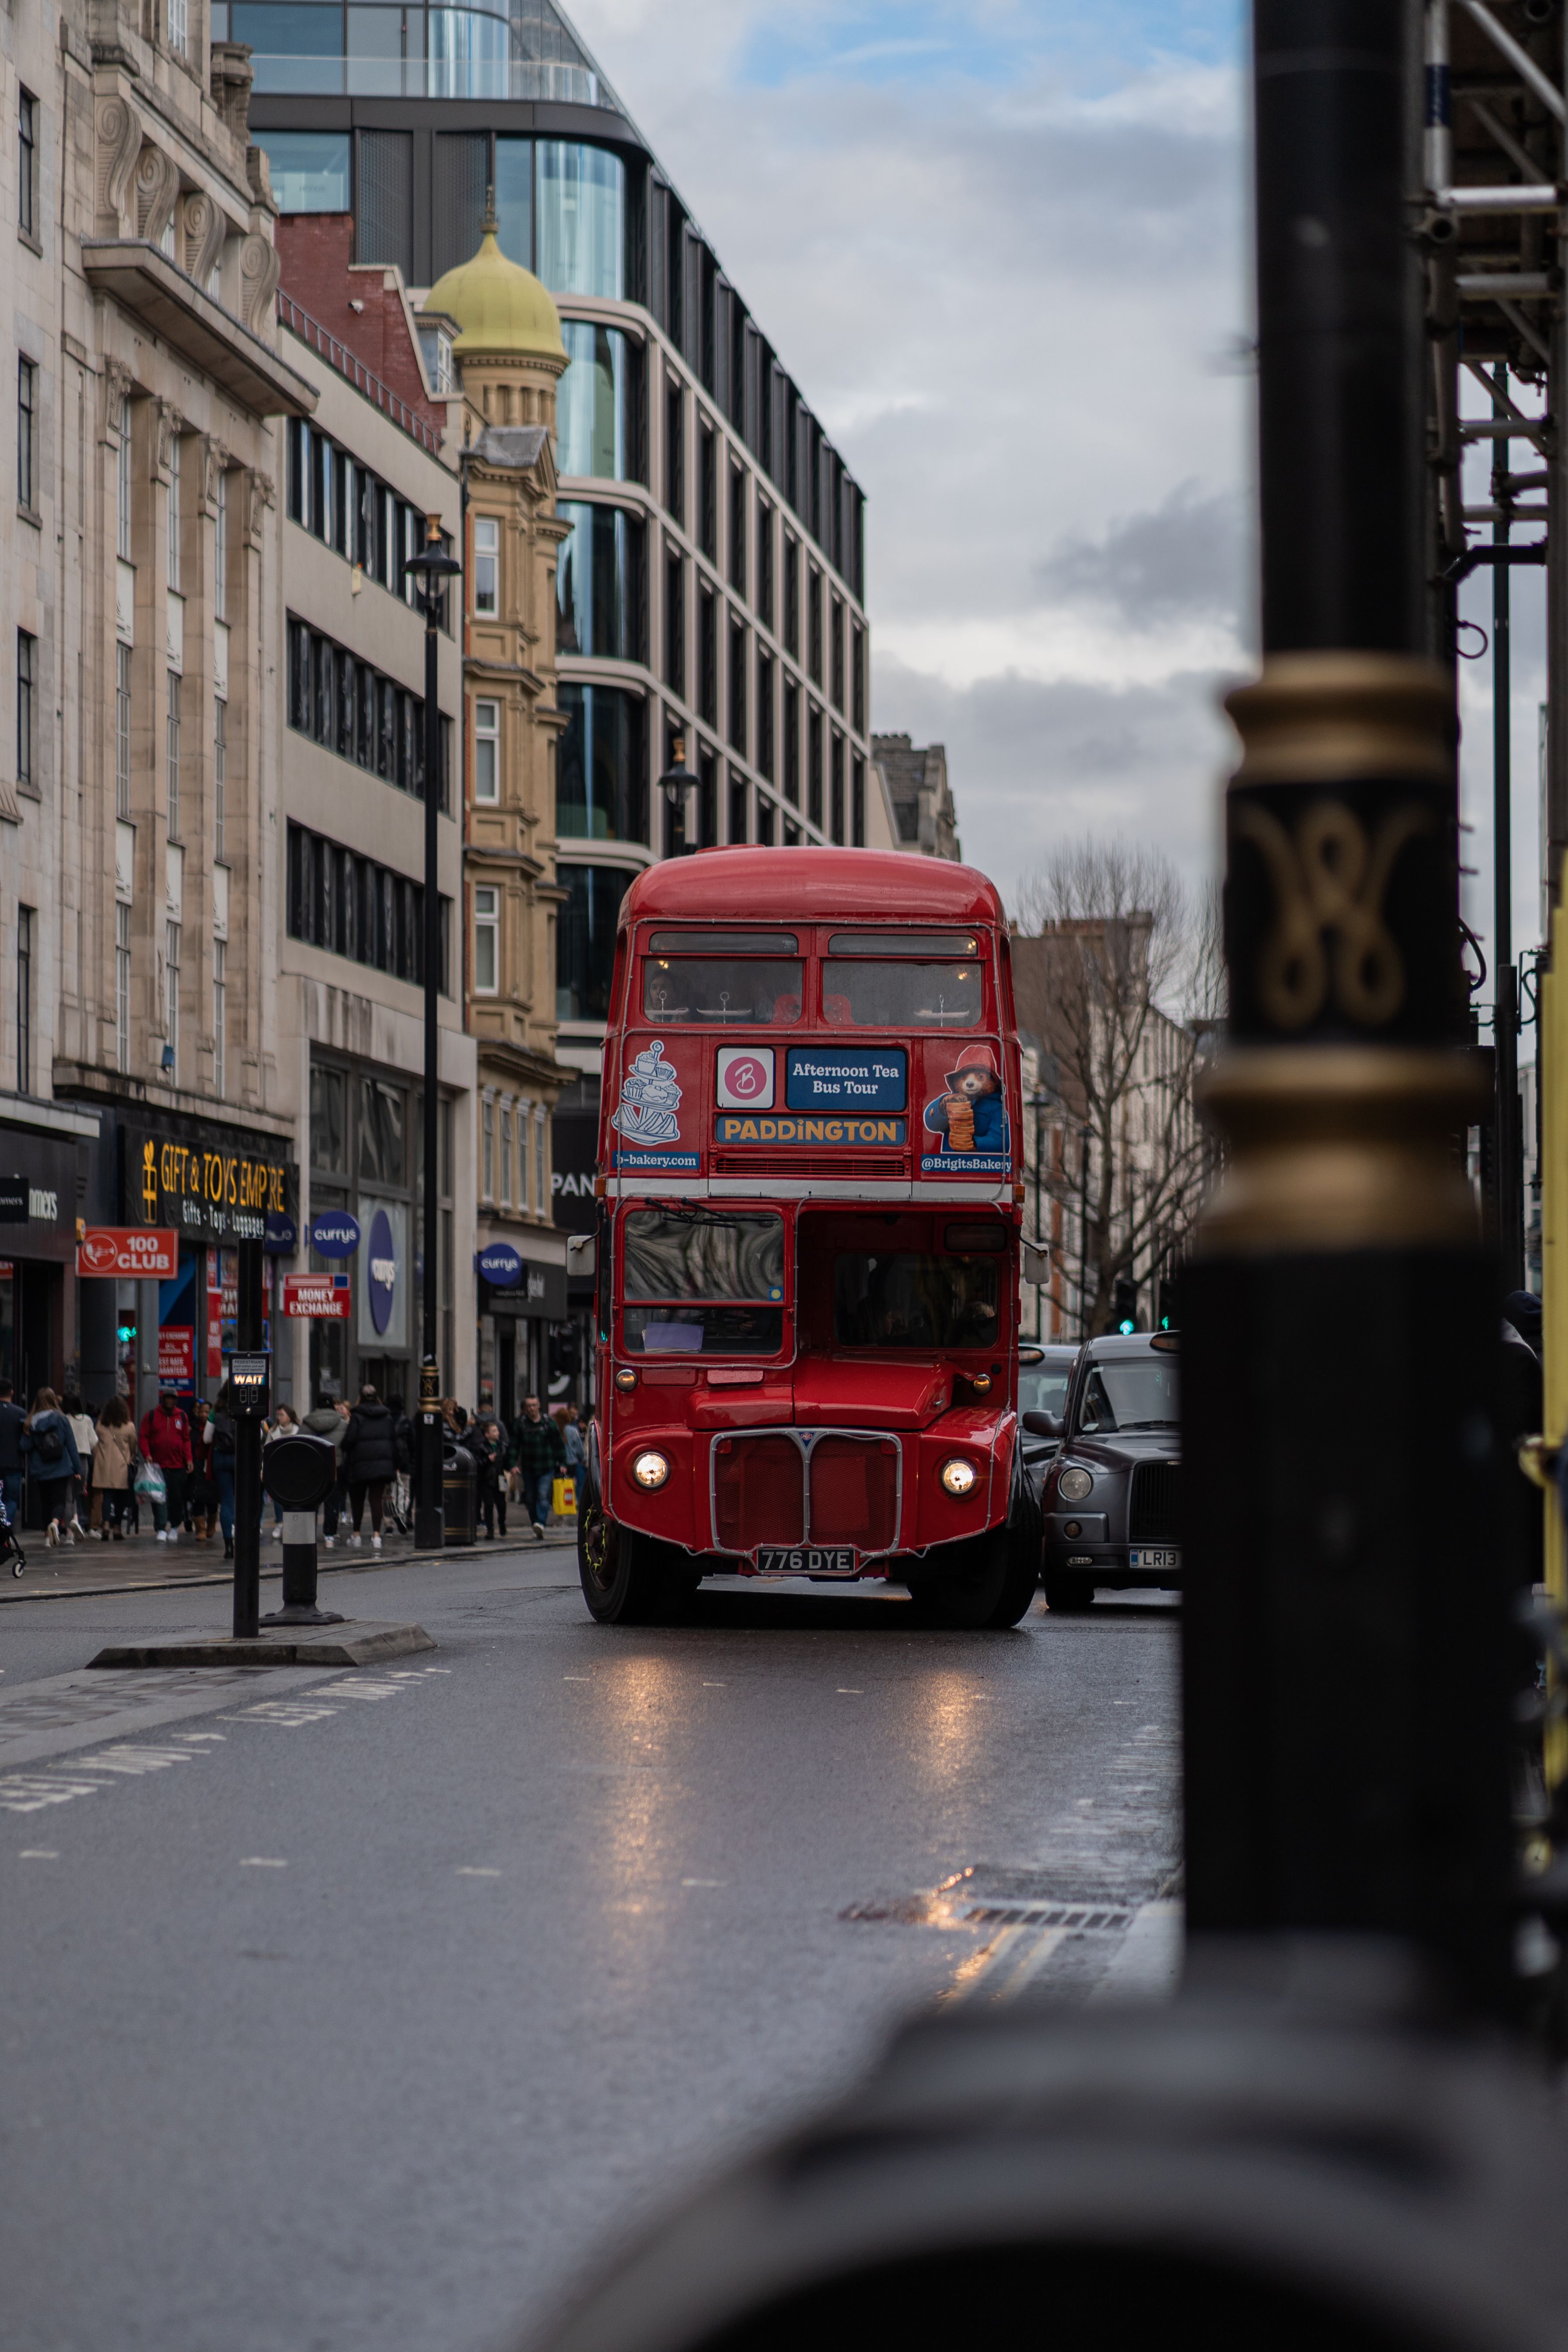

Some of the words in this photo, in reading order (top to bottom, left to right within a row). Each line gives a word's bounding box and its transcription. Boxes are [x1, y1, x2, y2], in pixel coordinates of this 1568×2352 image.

[793, 1063, 869, 1077] Afternoon
[872, 1065, 899, 1078] Tea
[813, 1081, 840, 1093] Bus
[844, 1081, 878, 1094] Tour
[725, 1119, 896, 1141] PADDINGTON
[616, 1155, 696, 1167] b-bakery.com
[921, 1158, 1012, 1172] @BrigitsBakery
[161, 1143, 189, 1195] GIFT
[190, 1155, 200, 1193] &
[204, 1153, 238, 1205] TOYS
[240, 1160, 285, 1213] EMPRE
[183, 1200, 201, 1226] Gifts
[209, 1204, 226, 1235] Toys
[314, 1228, 357, 1244] currys
[127, 1236, 159, 1252] 100
[118, 1252, 170, 1269] CLUB
[481, 1258, 519, 1272] currys
[298, 1289, 335, 1302] MONEY
[289, 1302, 343, 1315] EXCHANGE
[234, 1375, 263, 1384] WAIT
[762, 1552, 803, 1569] 776
[809, 1552, 849, 1569] DYE
[1143, 1552, 1176, 1566] LR13
